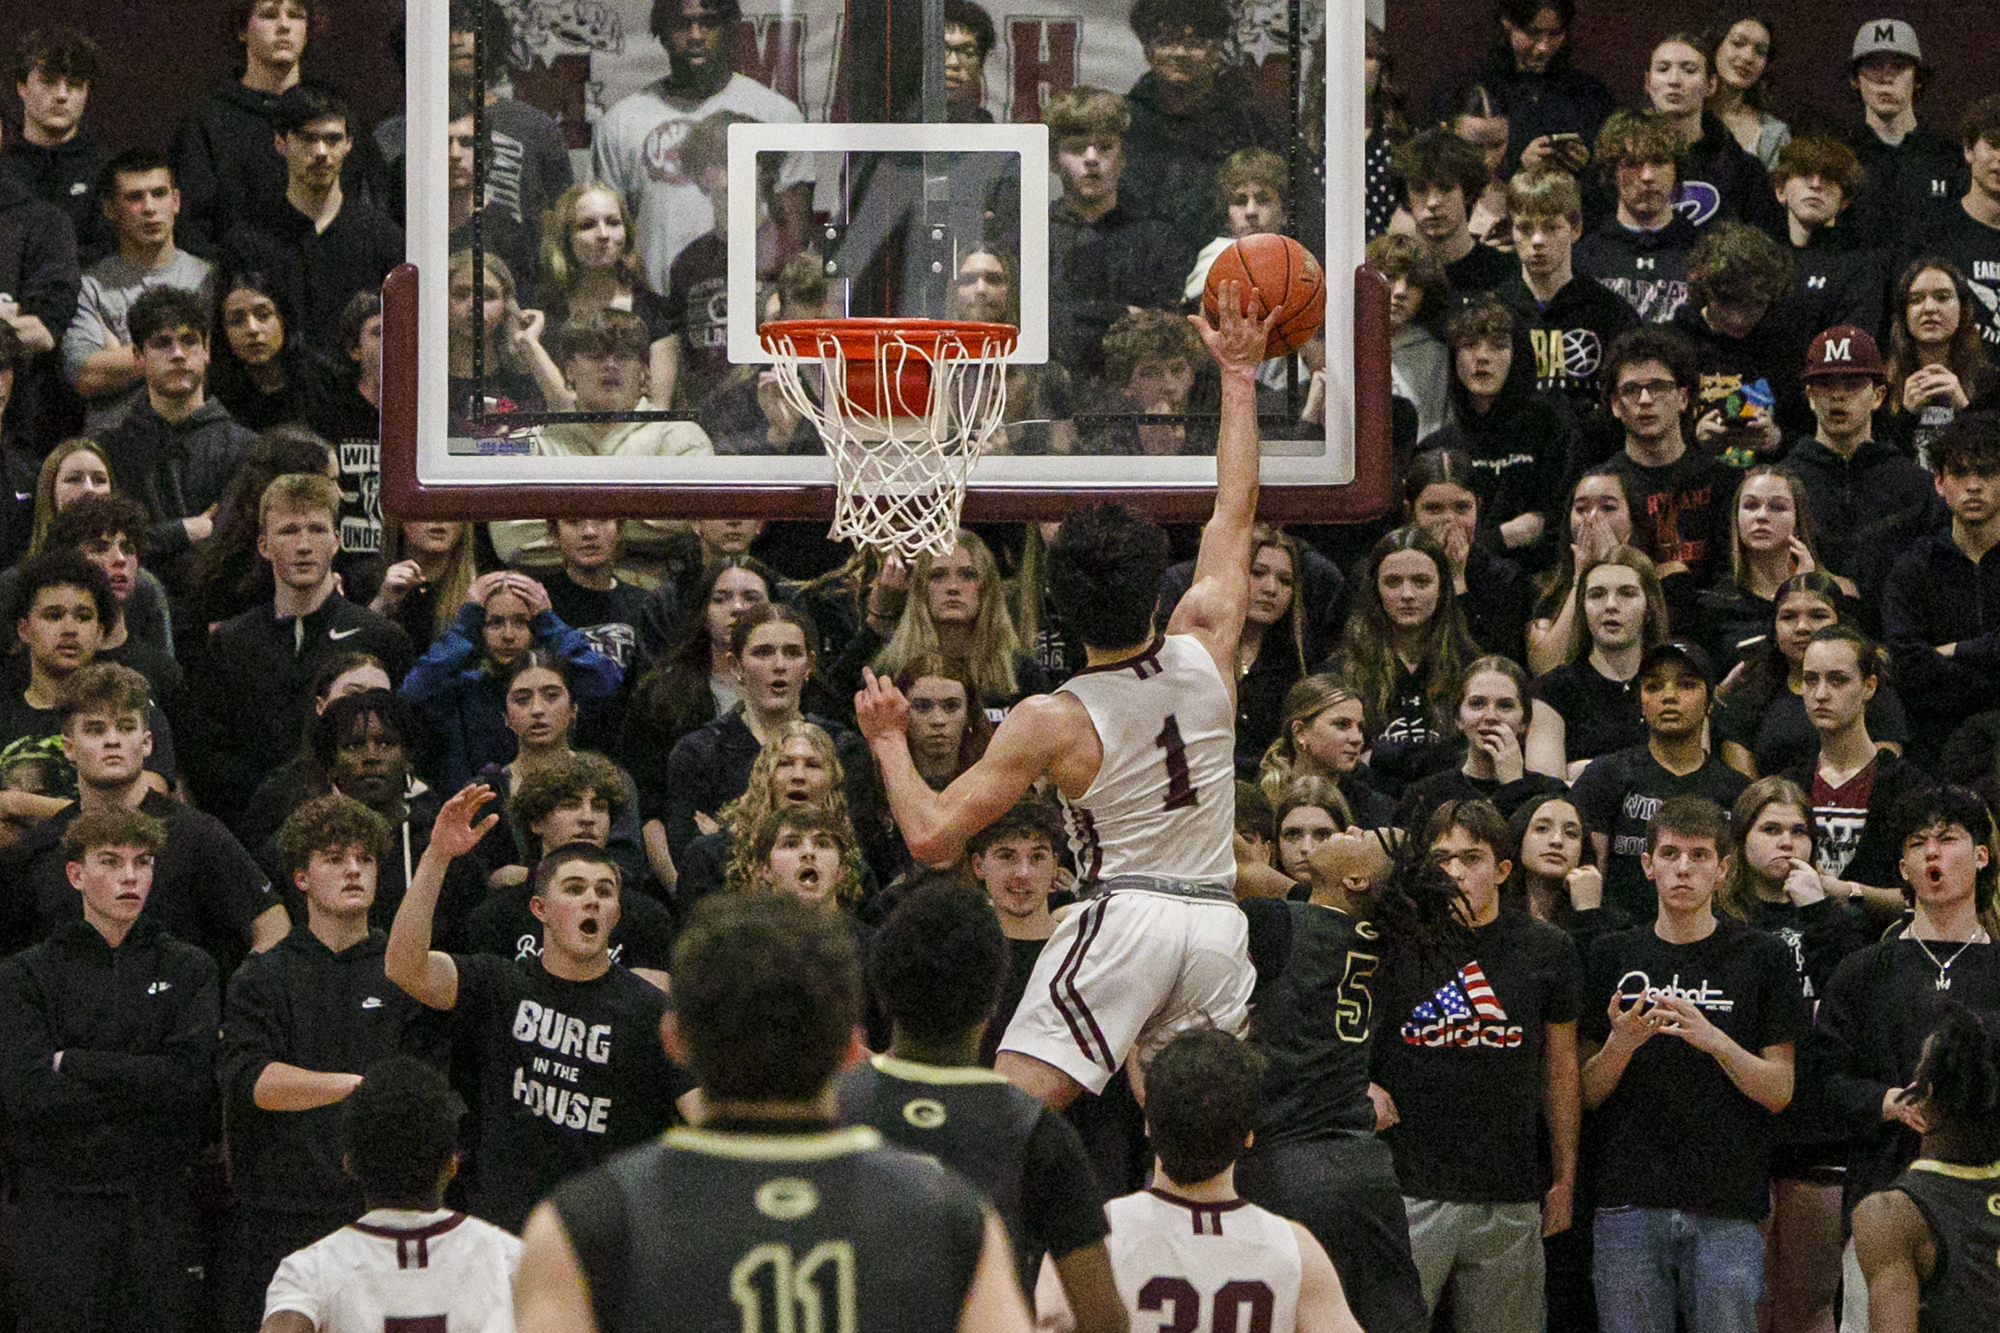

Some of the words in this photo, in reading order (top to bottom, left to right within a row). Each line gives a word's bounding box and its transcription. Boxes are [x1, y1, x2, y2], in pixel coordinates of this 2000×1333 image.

[1873, 23, 1895, 42] M
[1823, 337, 1852, 363] M
[1155, 712, 1200, 812] 1
[1335, 950, 1380, 1044] 5
[512, 999, 612, 1066] BURG
[1400, 1017, 1524, 1049] adidas
[513, 1066, 613, 1135] HOUSE
[533, 1056, 550, 1076] IN
[553, 1061, 580, 1083] THE
[730, 1240, 858, 1333] 11
